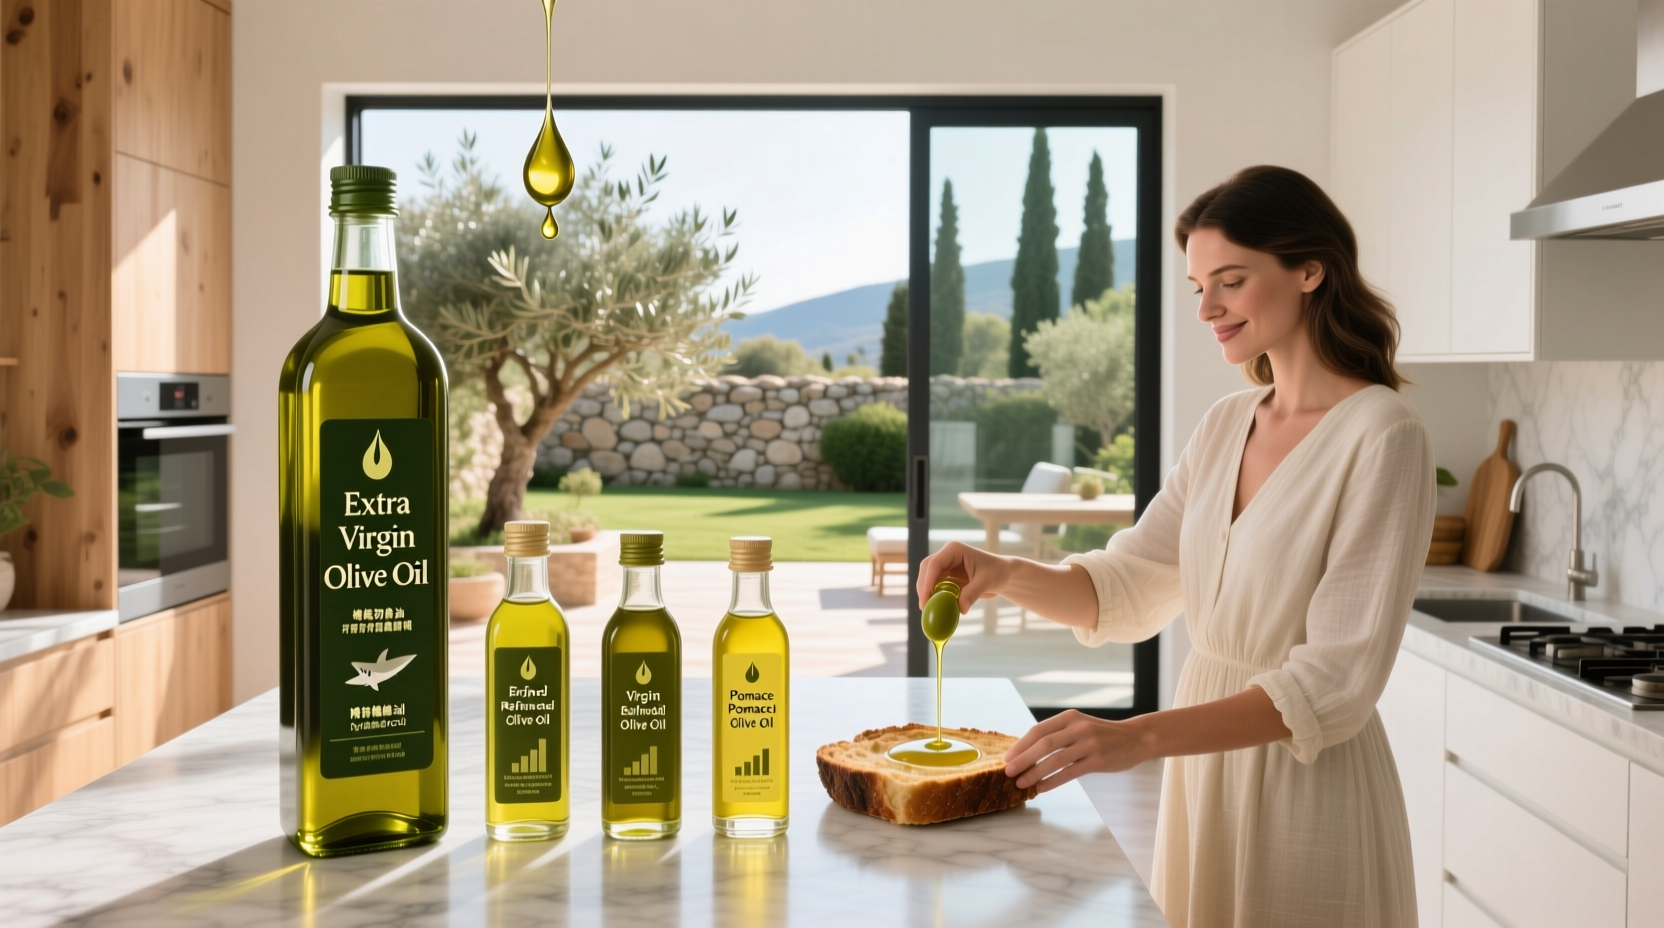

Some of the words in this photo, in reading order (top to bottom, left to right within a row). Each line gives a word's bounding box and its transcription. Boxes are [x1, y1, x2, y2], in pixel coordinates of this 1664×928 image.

[344, 491, 411, 516] Extra
[338, 524, 416, 557] Virgin
[324, 563, 388, 590] Olive
[392, 559, 429, 586] Oil
[626, 690, 661, 704] Virgin
[730, 689, 775, 701] Pomace
[505, 714, 534, 726] Olive
[535, 713, 550, 725] Oil
[620, 718, 648, 730] Olive
[650, 718, 666, 730] Oil
[730, 717, 756, 729] Olive
[759, 716, 774, 728] Oil
